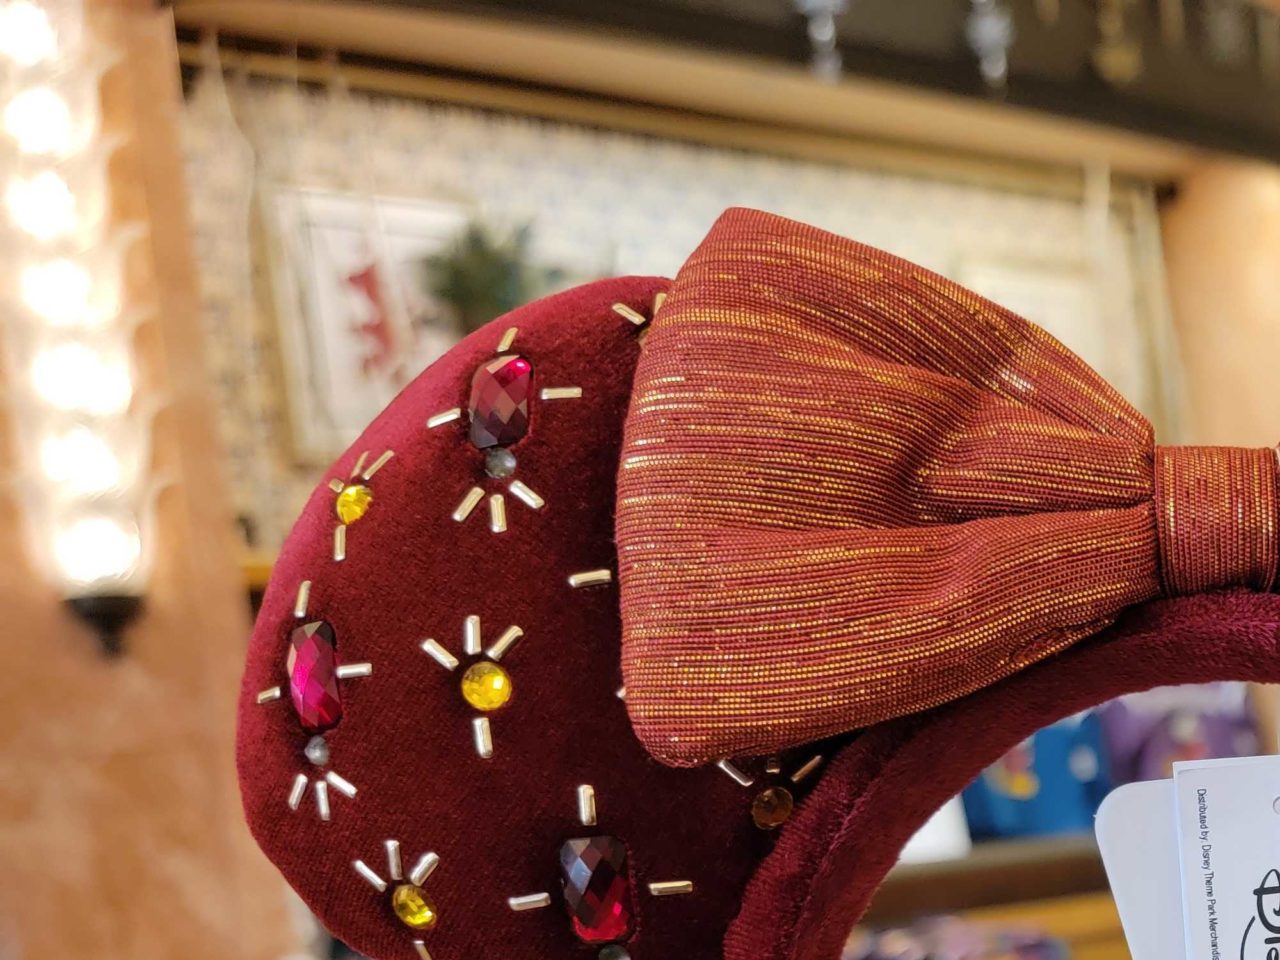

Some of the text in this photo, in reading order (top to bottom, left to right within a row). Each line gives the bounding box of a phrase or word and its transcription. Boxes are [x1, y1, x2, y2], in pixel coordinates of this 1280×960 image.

[1197, 788, 1209, 830] Distributed
[1201, 844, 1212, 870] Disney
[1204, 871, 1215, 898] Theme
[1207, 898, 1217, 917] Park
